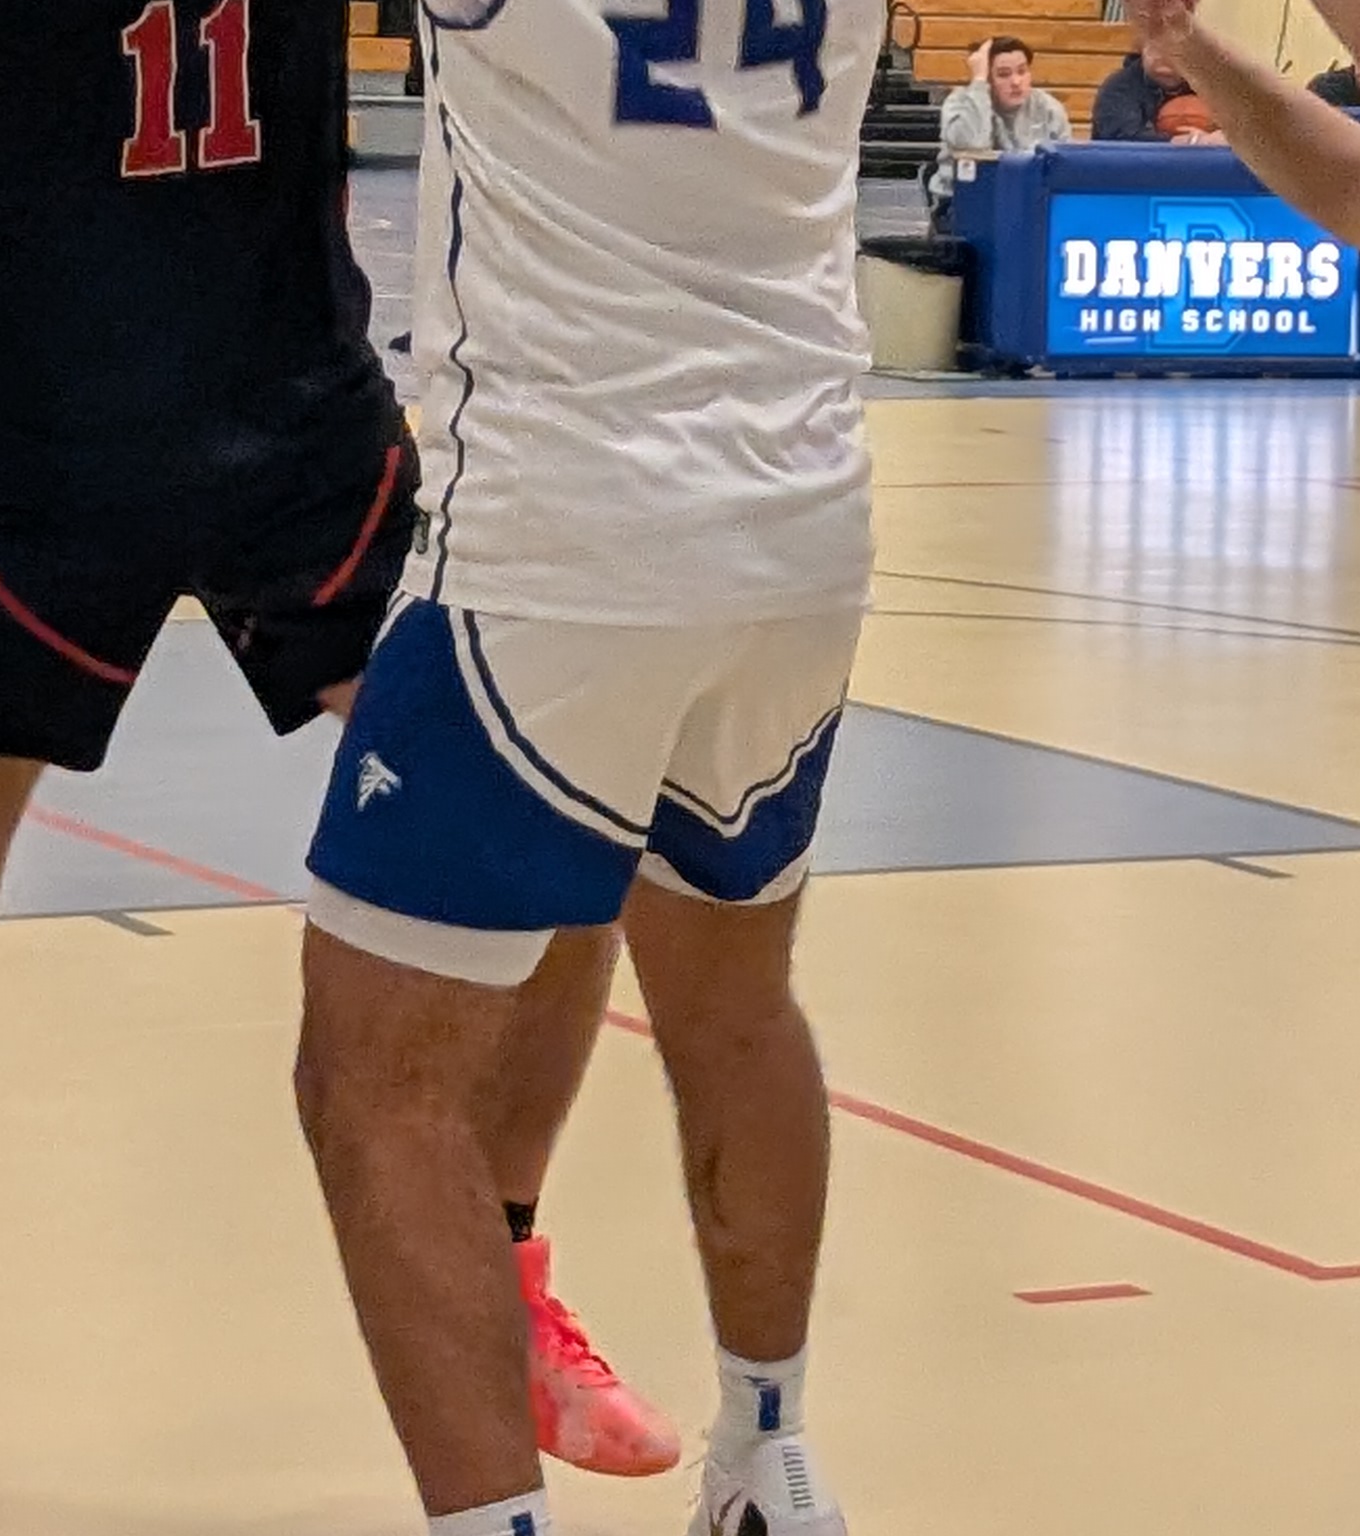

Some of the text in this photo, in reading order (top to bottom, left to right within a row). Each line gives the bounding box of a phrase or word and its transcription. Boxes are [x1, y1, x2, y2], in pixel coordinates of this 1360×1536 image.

[1059, 240, 1341, 298] DANVERS
[1080, 309, 1317, 333] HIGH SCHOOL
